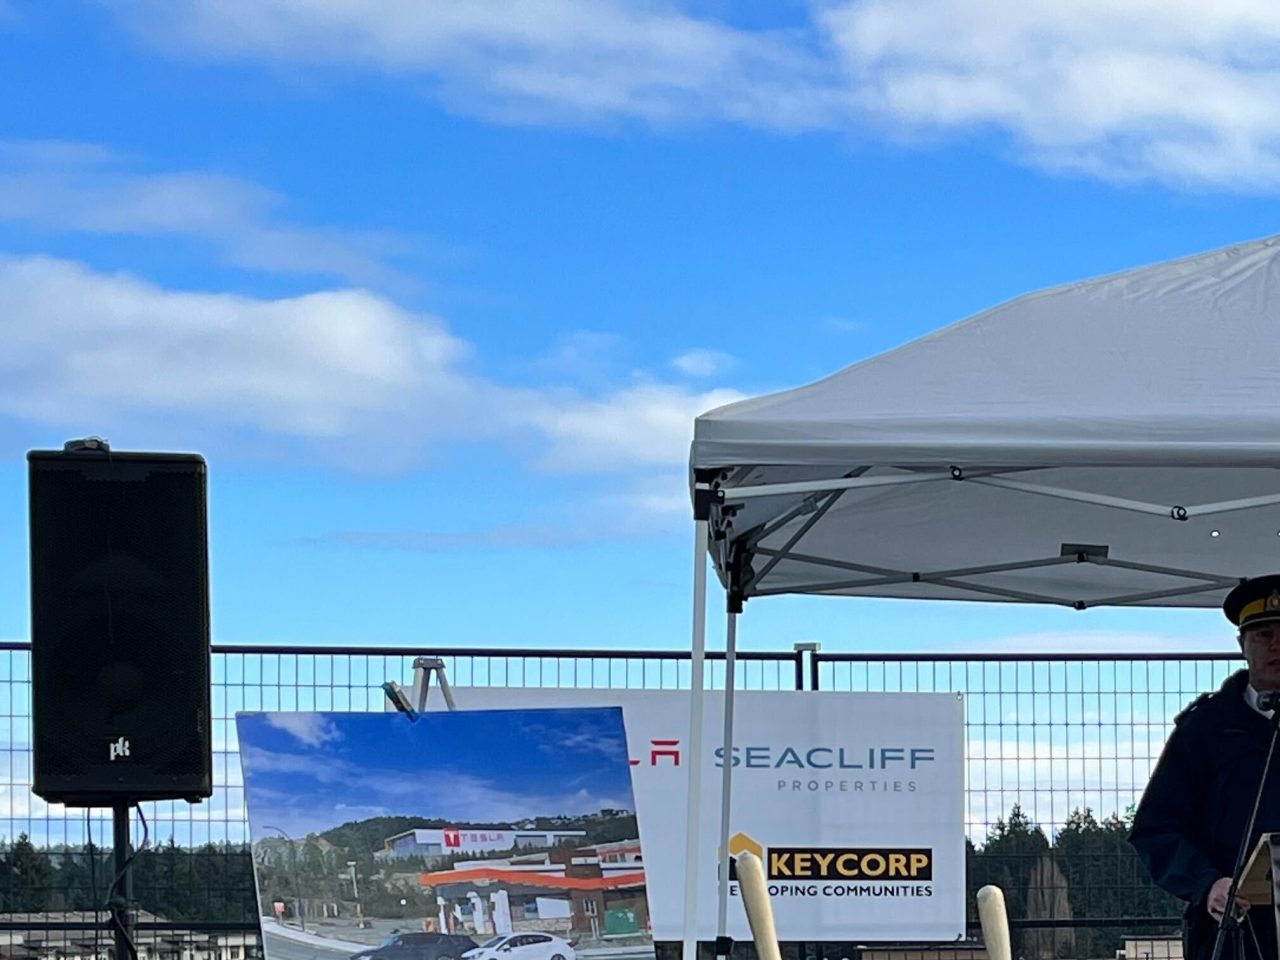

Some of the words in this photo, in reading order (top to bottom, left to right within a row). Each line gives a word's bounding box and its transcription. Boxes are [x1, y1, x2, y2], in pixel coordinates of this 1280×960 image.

[714, 746, 935, 769] SEACLIFF
[777, 779, 917, 792] PROPERTIES
[770, 852, 929, 877] KEYCORP
[718, 884, 818, 897] EOPING
[822, 884, 933, 897] COMMUNITIES
